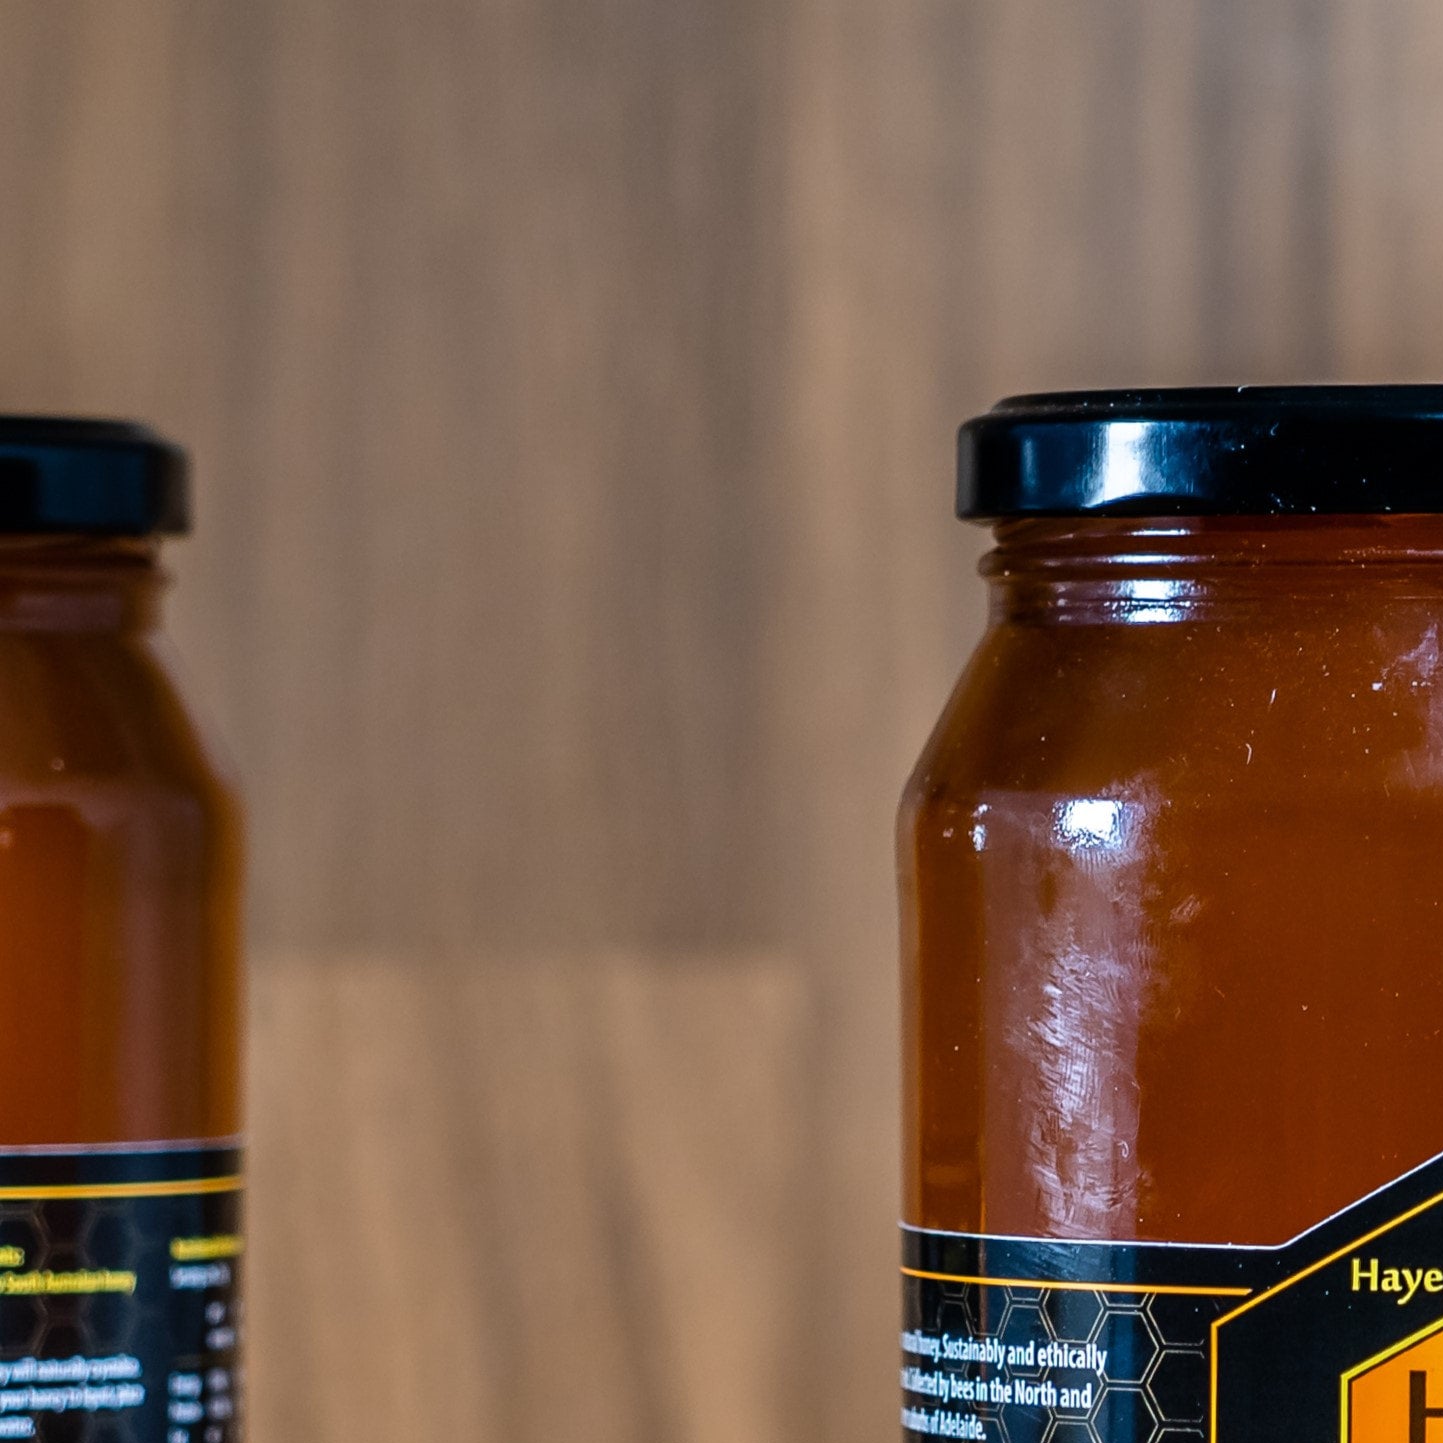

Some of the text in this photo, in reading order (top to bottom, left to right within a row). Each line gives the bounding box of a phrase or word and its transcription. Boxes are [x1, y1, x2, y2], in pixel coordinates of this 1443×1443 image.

[943, 1333, 1006, 1370] Sustainably
[1007, 1340, 1035, 1366] and
[1037, 1342, 1108, 1377] ethically
[951, 1373, 975, 1400] bees
[975, 1376, 988, 1402] in
[990, 1377, 1013, 1404] the
[1015, 1379, 1057, 1407] North
[1060, 1383, 1093, 1409] and
